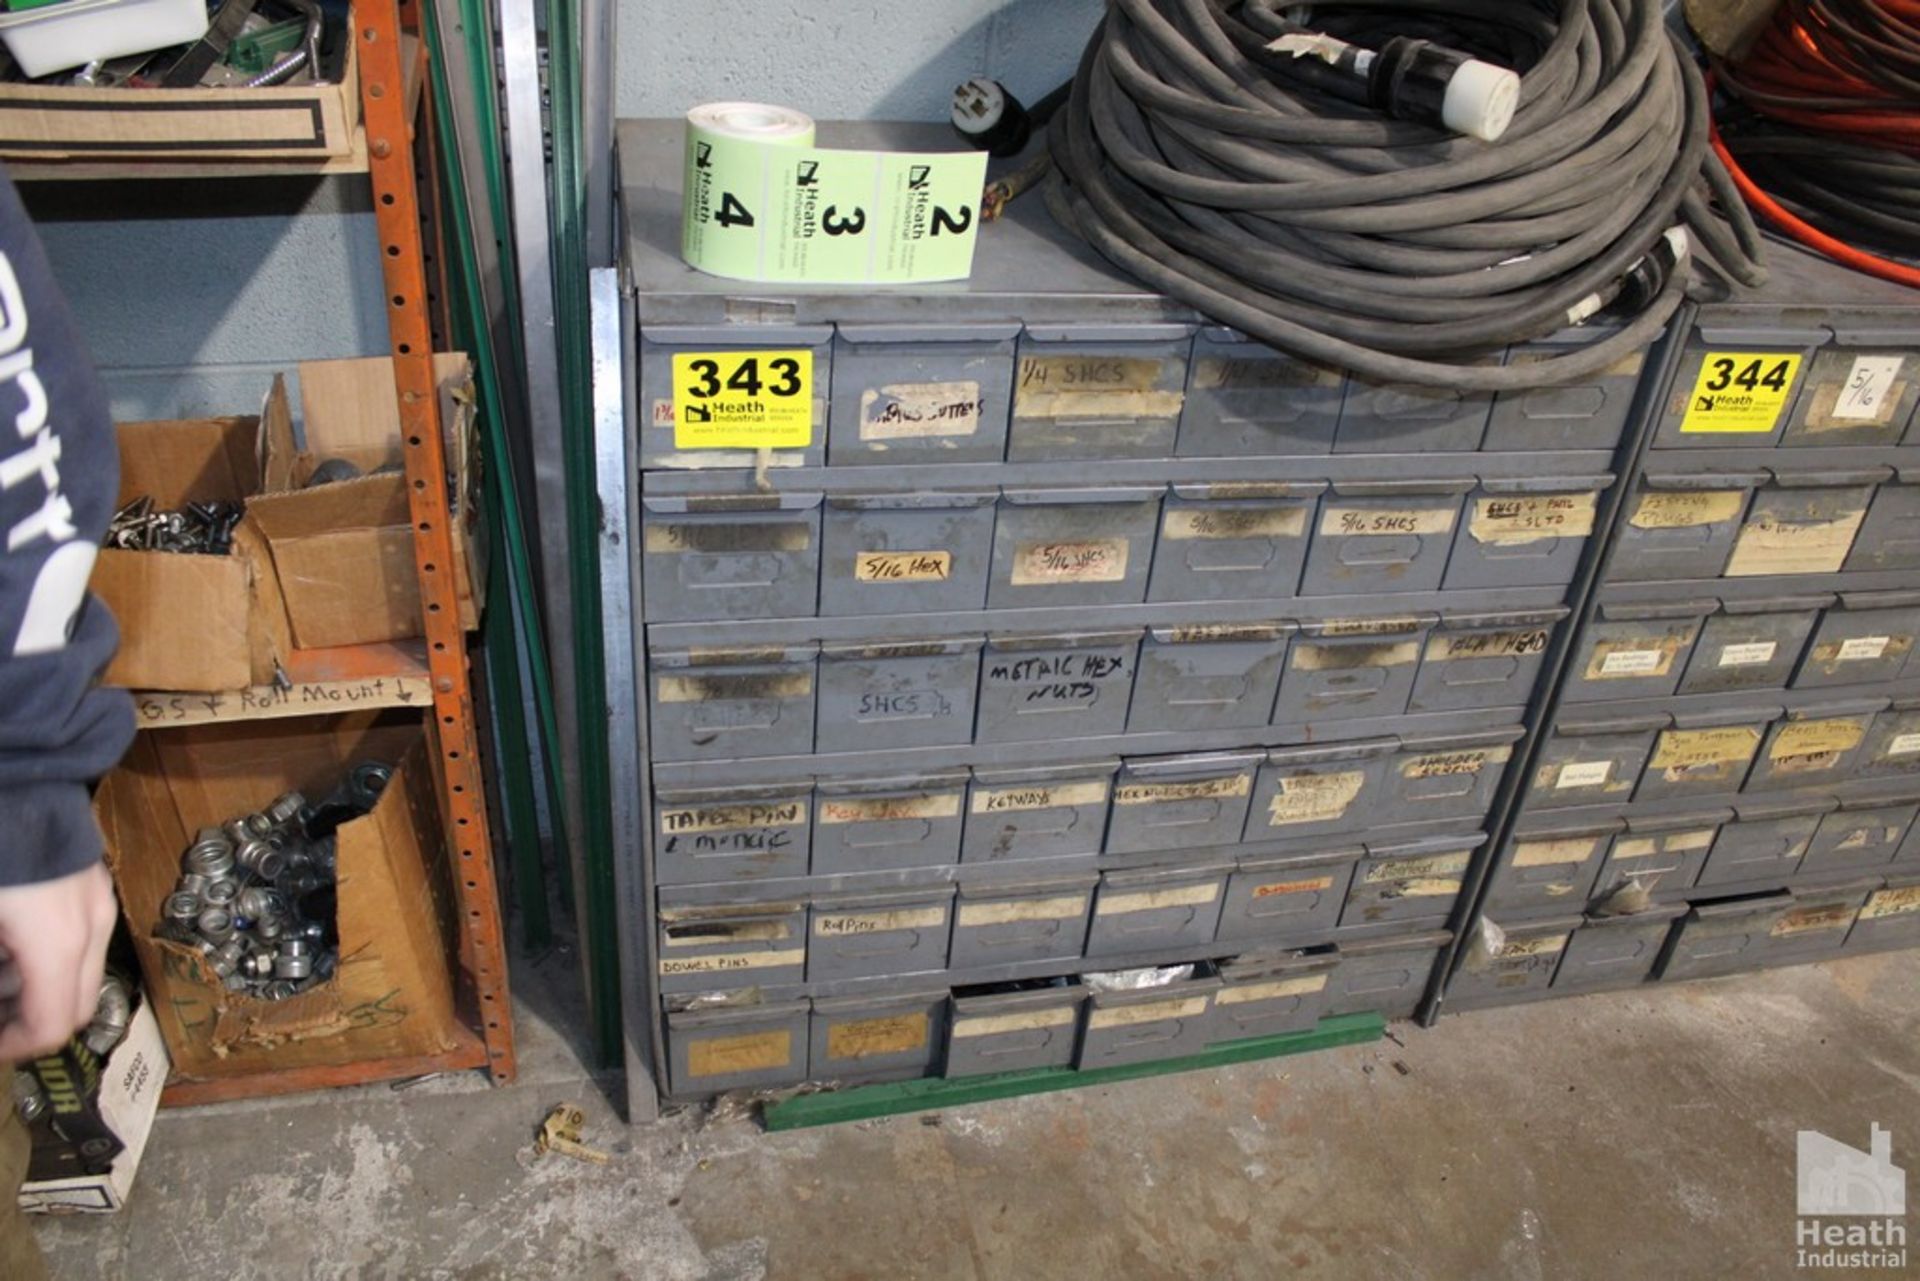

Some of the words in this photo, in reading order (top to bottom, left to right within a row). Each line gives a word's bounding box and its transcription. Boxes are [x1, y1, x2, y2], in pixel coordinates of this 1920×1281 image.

[700, 172, 712, 224] Heath
[714, 192, 754, 228] 4
[792, 189, 805, 239] Industrial
[803, 188, 819, 238] Heath
[822, 205, 865, 236] 3
[901, 193, 914, 241] Industrial
[912, 191, 929, 240] Heath
[930, 205, 971, 236] 2
[688, 358, 801, 398] 343
[1023, 358, 1048, 387] 1/4
[1063, 360, 1124, 384] SHCS
[1706, 358, 1790, 392] 344
[1715, 395, 1753, 404] Heath
[1848, 367, 1875, 407] 5/16
[712, 401, 764, 413] Heath
[713, 414, 765, 422] Industrial
[1371, 516, 1417, 532] SHCS
[866, 557, 904, 579] 5/16
[1503, 631, 1548, 654] HEAD
[990, 656, 1072, 681] METRIC
[1083, 655, 1123, 676] HEX
[302, 678, 384, 702] Mount
[858, 693, 920, 714] SHCS
[1026, 684, 1095, 703] NUTS
[664, 811, 733, 830] TAPER
[718, 957, 749, 968] PINS
